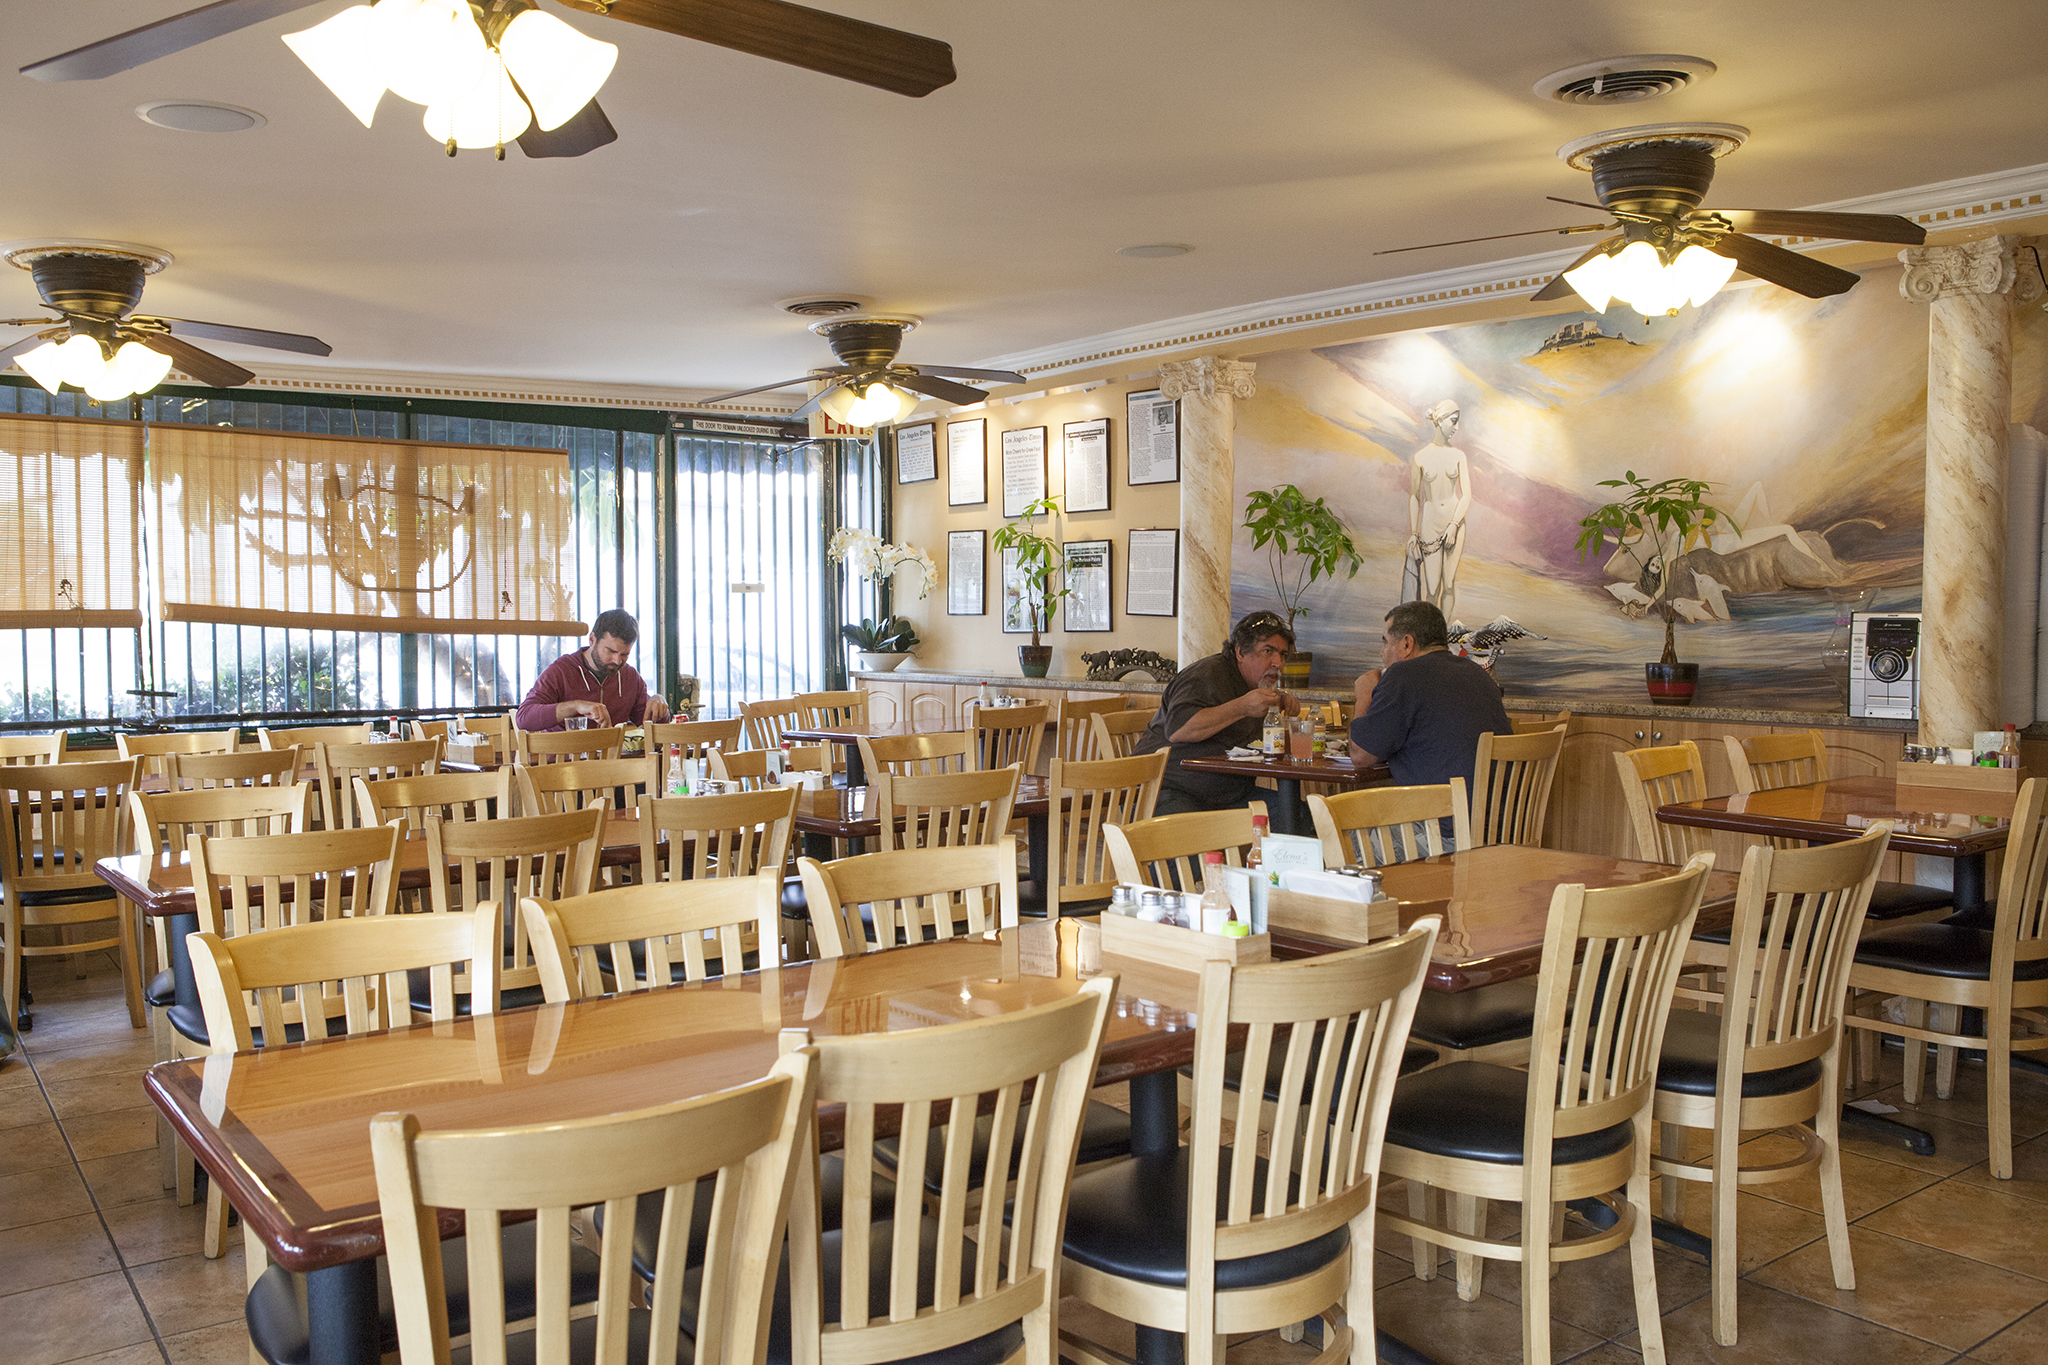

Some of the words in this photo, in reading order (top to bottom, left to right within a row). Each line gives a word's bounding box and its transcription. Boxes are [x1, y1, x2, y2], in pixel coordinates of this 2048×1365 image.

[705, 422, 716, 430] DOOR
[737, 425, 755, 433] UNLOCKED
[1272, 849, 1308, 861] Elena's
